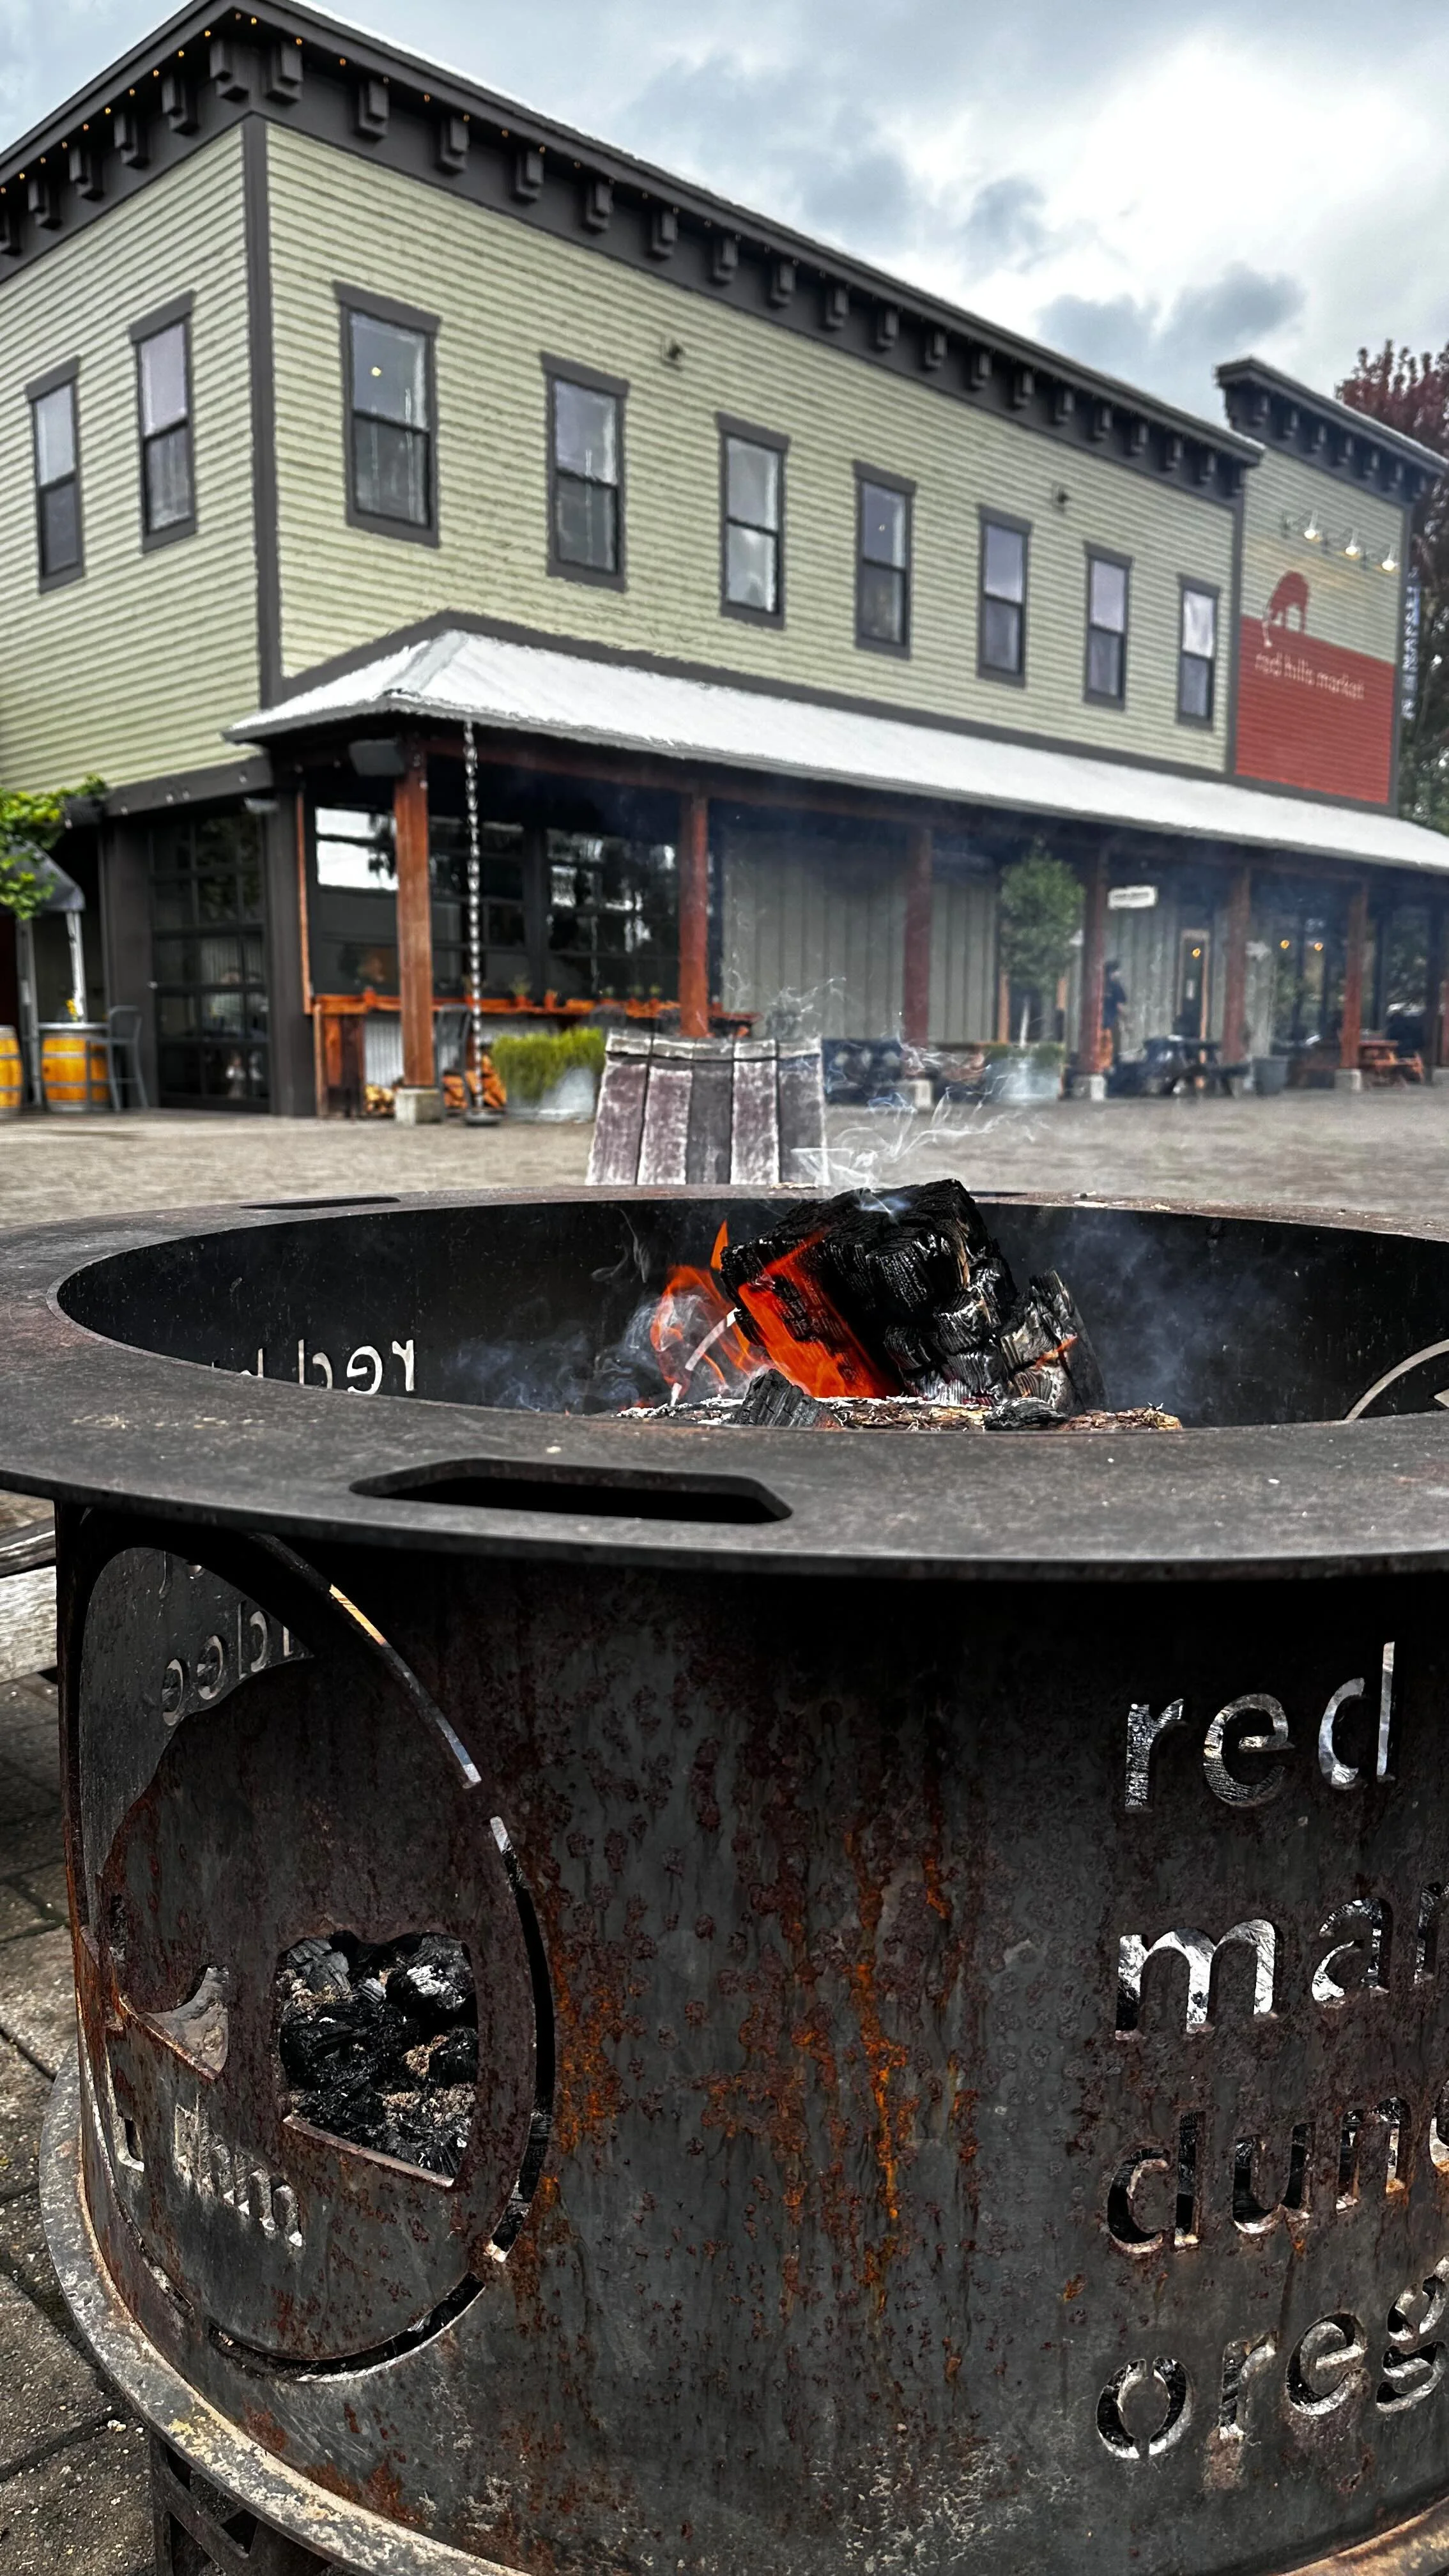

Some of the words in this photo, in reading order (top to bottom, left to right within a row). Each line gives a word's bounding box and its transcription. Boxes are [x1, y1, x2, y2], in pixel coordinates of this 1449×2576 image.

[1255, 651, 1283, 677] red
[1284, 654, 1315, 686] hills
[1316, 671, 1365, 700] market
[1124, 1641, 1395, 1813] red
[1107, 2080, 1449, 2255] dun
